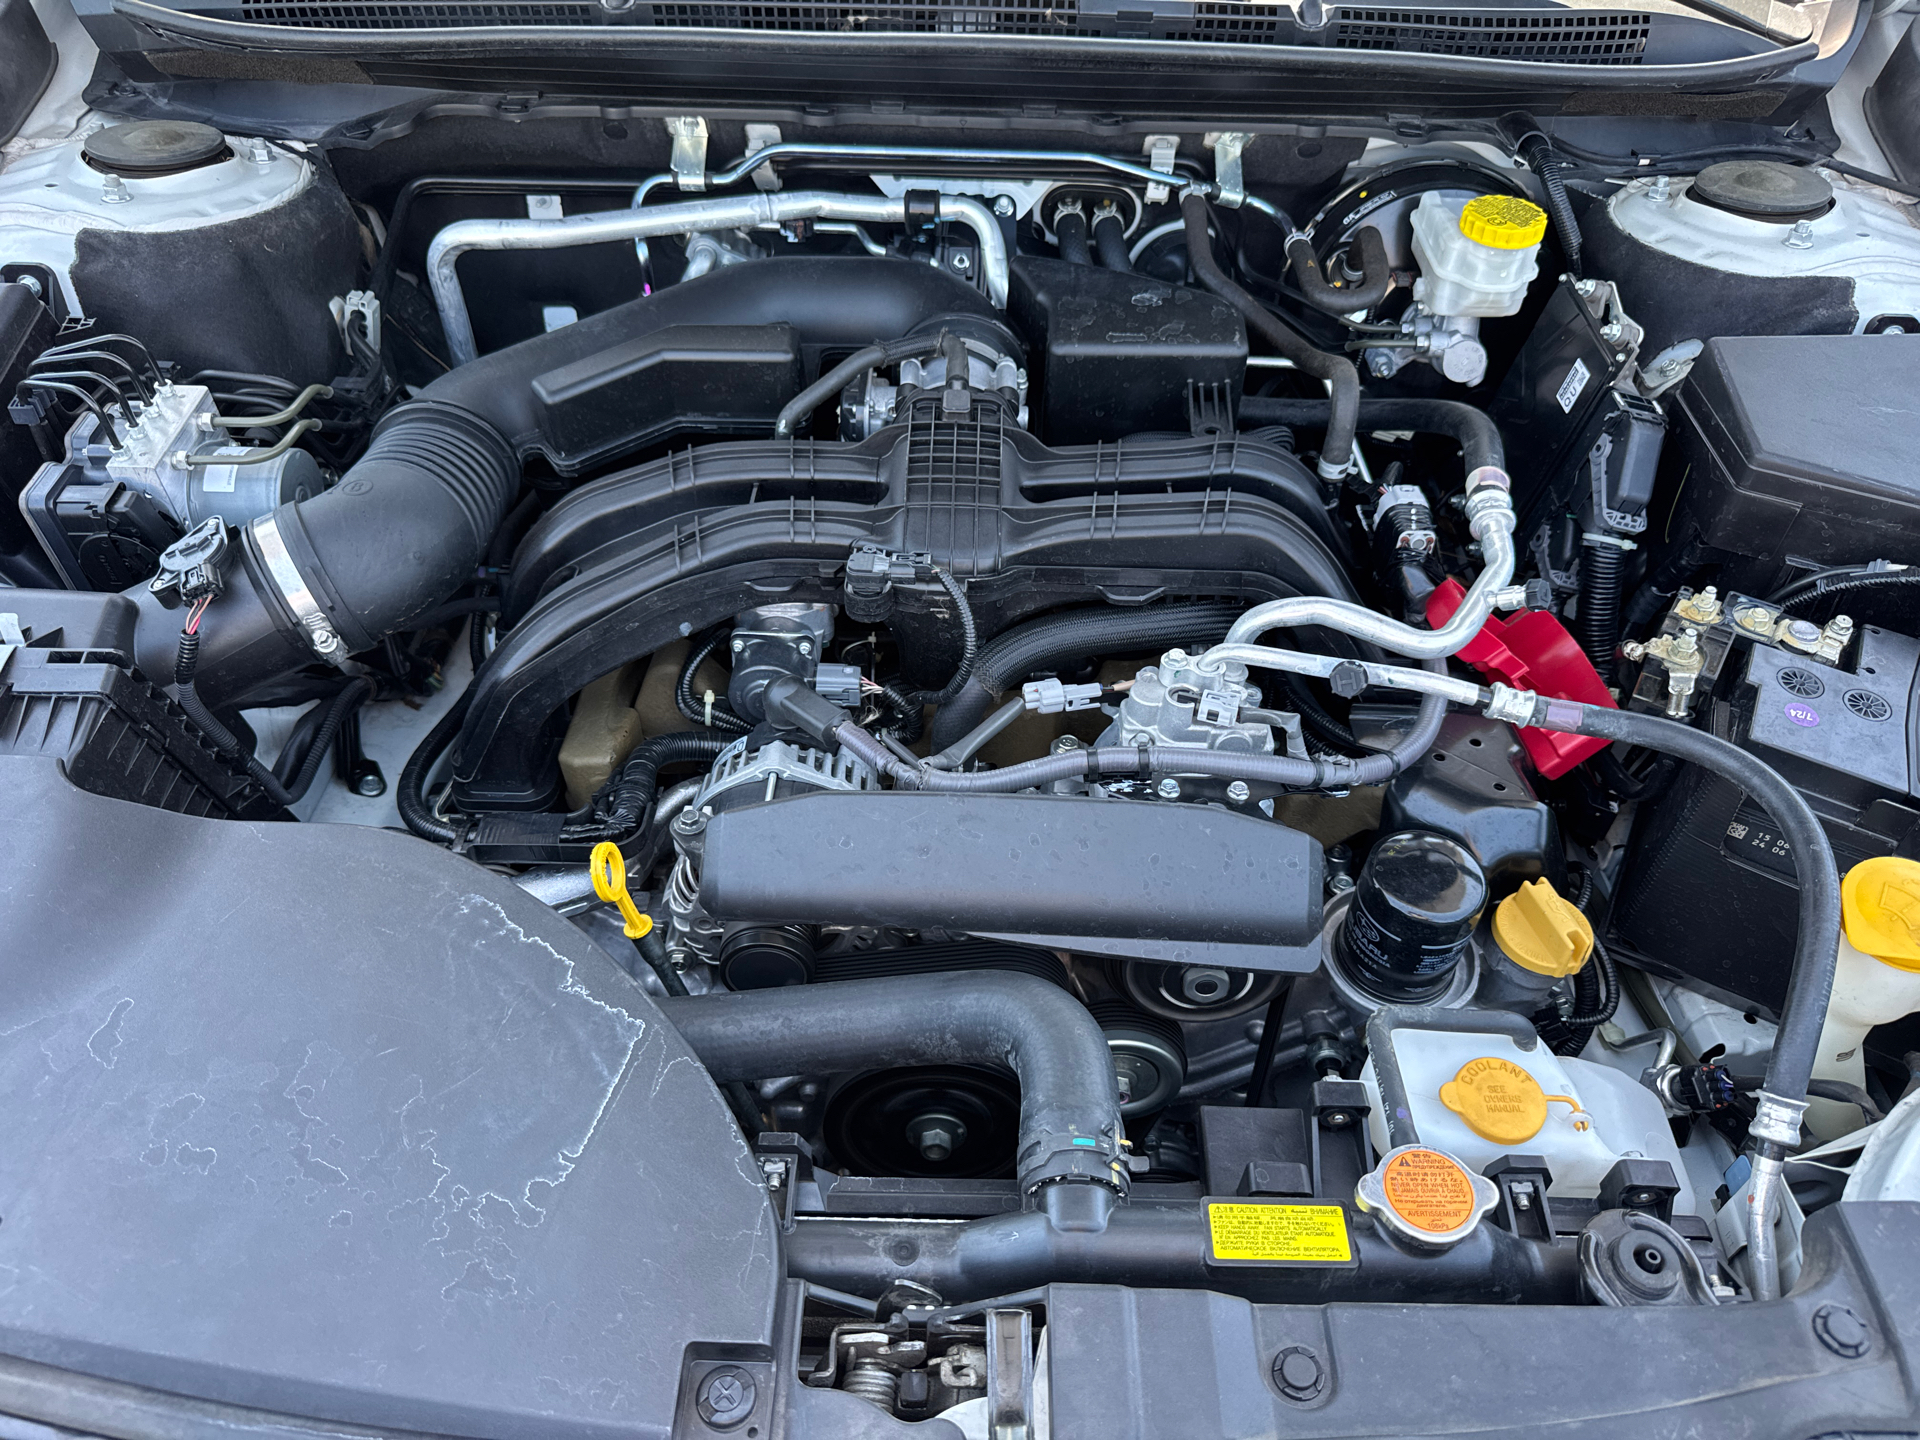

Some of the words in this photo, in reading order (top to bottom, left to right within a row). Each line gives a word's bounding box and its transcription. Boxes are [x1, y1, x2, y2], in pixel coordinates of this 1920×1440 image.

[1758, 832, 1771, 841] 15
[1751, 839, 1765, 848] 24
[1771, 846, 1786, 856] 06
[1461, 1060, 1532, 1086] COOLANT
[1487, 1085, 1507, 1094] SEE
[1236, 1206, 1259, 1214] CAUTION
[1408, 1210, 1461, 1218] AVERTISSEMENT
